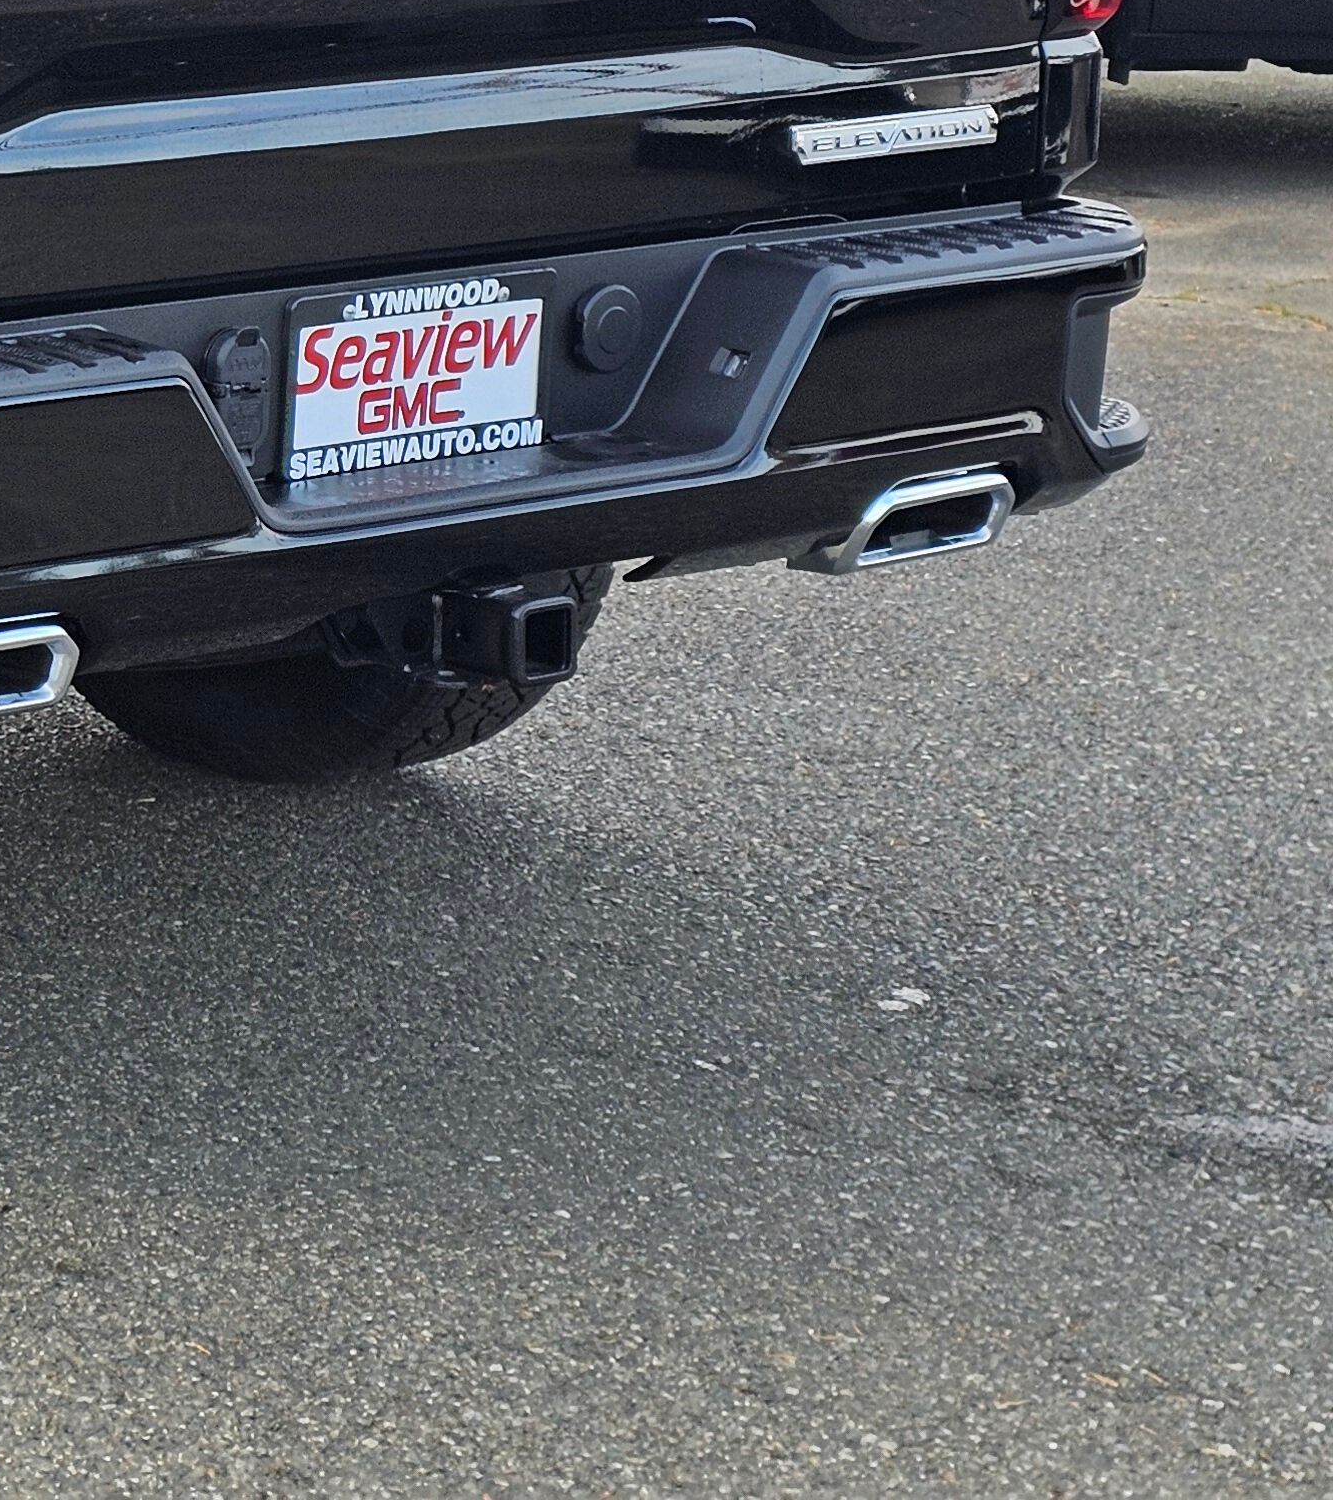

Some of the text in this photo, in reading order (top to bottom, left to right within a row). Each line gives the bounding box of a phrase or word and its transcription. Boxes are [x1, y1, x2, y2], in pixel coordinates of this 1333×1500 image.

[811, 118, 984, 153] ELEVATION
[353, 278, 501, 320] LYNNWOOD
[293, 310, 539, 396] Seaview
[357, 377, 462, 436] GMC
[288, 419, 544, 481] SEAVIEWAUTO.COM
